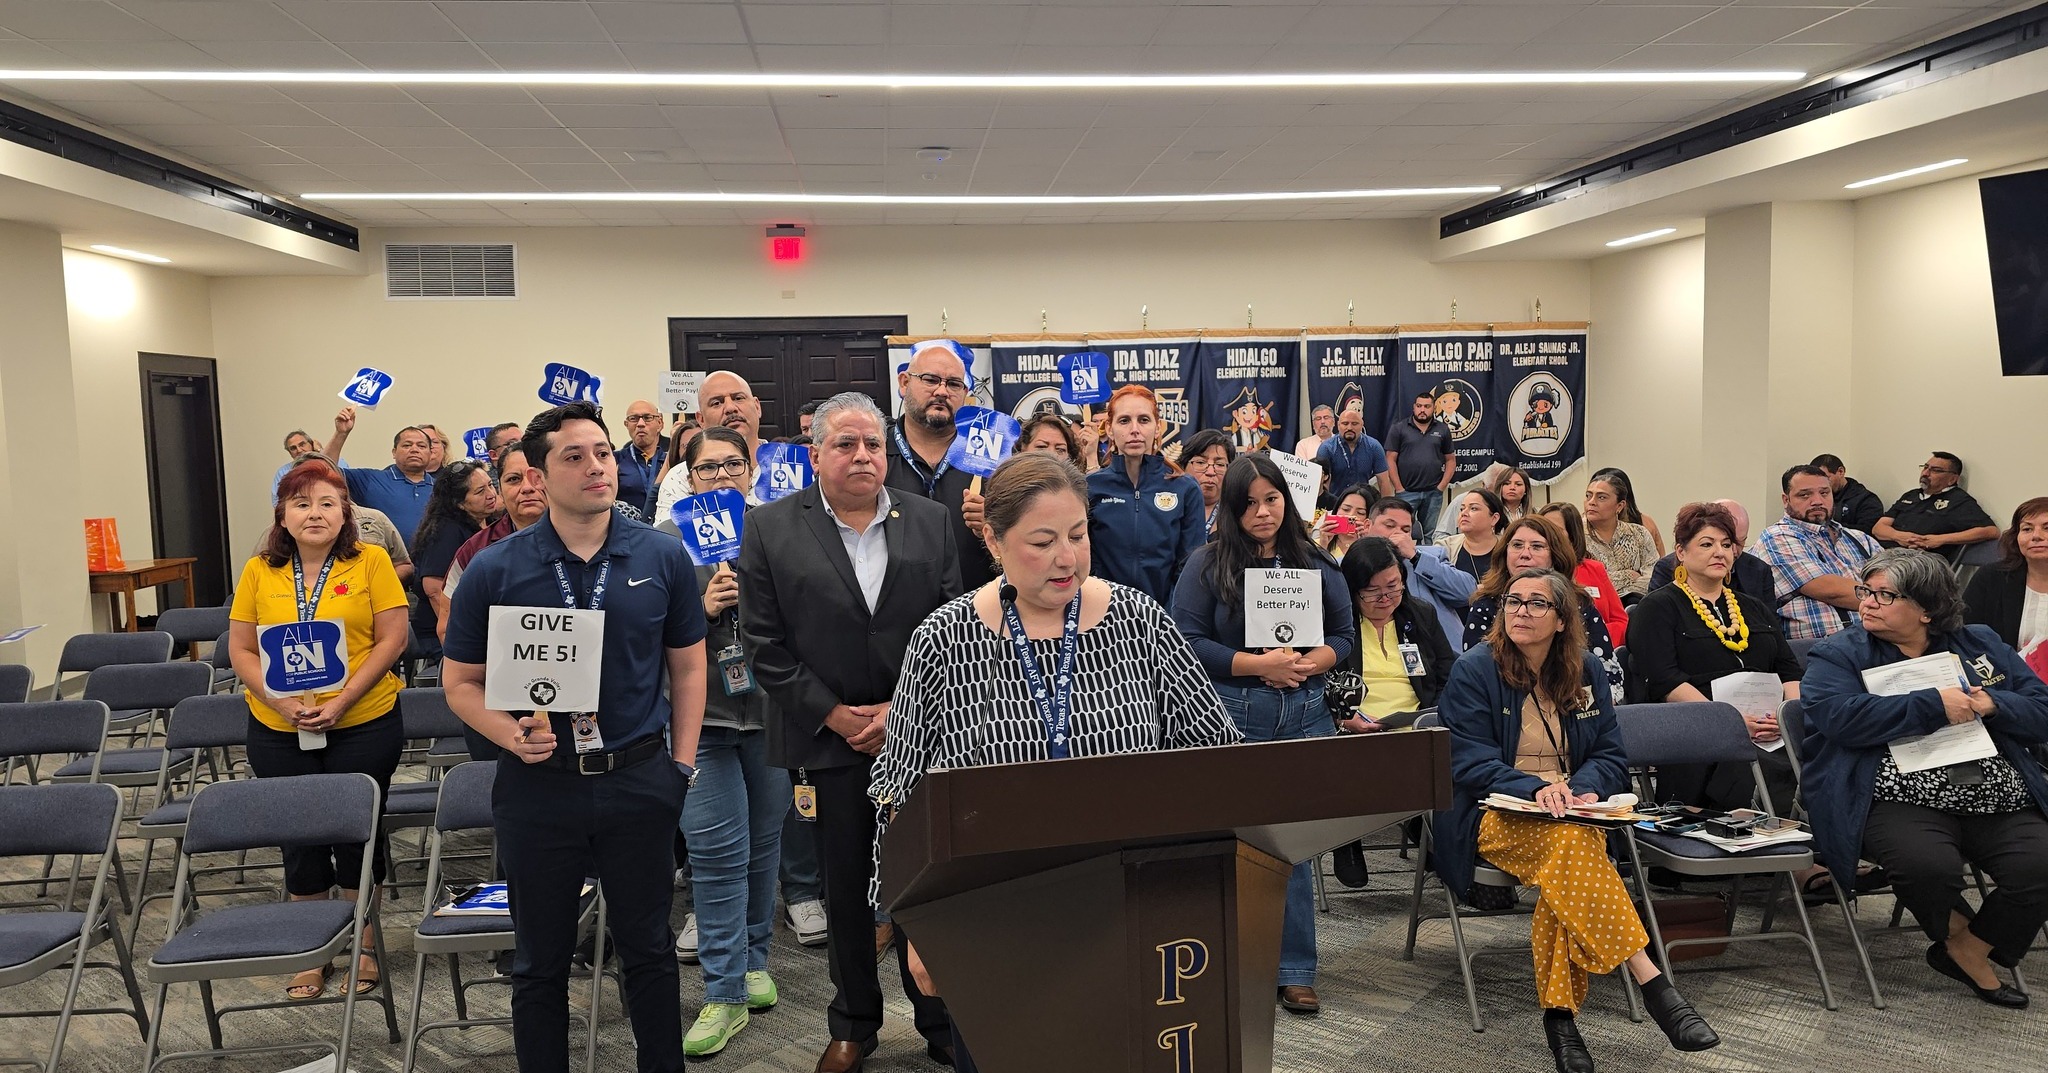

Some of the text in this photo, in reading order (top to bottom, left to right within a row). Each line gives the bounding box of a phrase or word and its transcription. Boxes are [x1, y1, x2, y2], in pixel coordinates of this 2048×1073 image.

[1322, 347, 1384, 366] J.C. KELLY
[1407, 342, 1463, 362] HIDALGO
[1500, 344, 1513, 355] DR.
[1568, 342, 1581, 354] JR.
[1018, 355, 1065, 371] HIDAL
[1071, 355, 1097, 370] ALL
[1114, 349, 1179, 370] IDA DIAZ
[1227, 348, 1278, 367] HIDALGO
[1513, 356, 1548, 367] ELEMENTARY
[556, 366, 578, 382] ALL
[1216, 366, 1287, 379] ELEMENTARY SCHOOL
[1321, 365, 1386, 378] ELEMENTARY SCHOOL
[1416, 361, 1492, 373] ELEMENTARY SCHOOL
[1002, 373, 1064, 384] EARLY COLLEGE HIG
[1114, 370, 1180, 383] JR. HIGH SCHOOL
[772, 446, 804, 465] ALL
[1284, 454, 1309, 467] We ALL
[1280, 464, 1308, 480] Deserve
[1519, 461, 1550, 470] Established
[1295, 482, 1311, 494] Pay!
[692, 494, 730, 519] ALL
[555, 561, 571, 593] Texas AFT
[597, 568, 608, 585] Texas
[1265, 571, 1301, 579] We ALL
[1264, 586, 1303, 594] Deserve
[1068, 595, 1079, 619] Texas
[1257, 600, 1310, 611] Better Pay!
[520, 613, 574, 632] GIVE
[1008, 615, 1022, 632] AFT
[282, 625, 323, 646] ALL
[513, 644, 577, 663] ME 5!
[1060, 633, 1075, 674] Texas AFT
[1020, 646, 1042, 686] Texas AFT
[524, 682, 532, 690] Rio
[550, 678, 562, 691] Valley
[1040, 699, 1054, 724] Texas
[1056, 689, 1067, 732] Texas AFT
